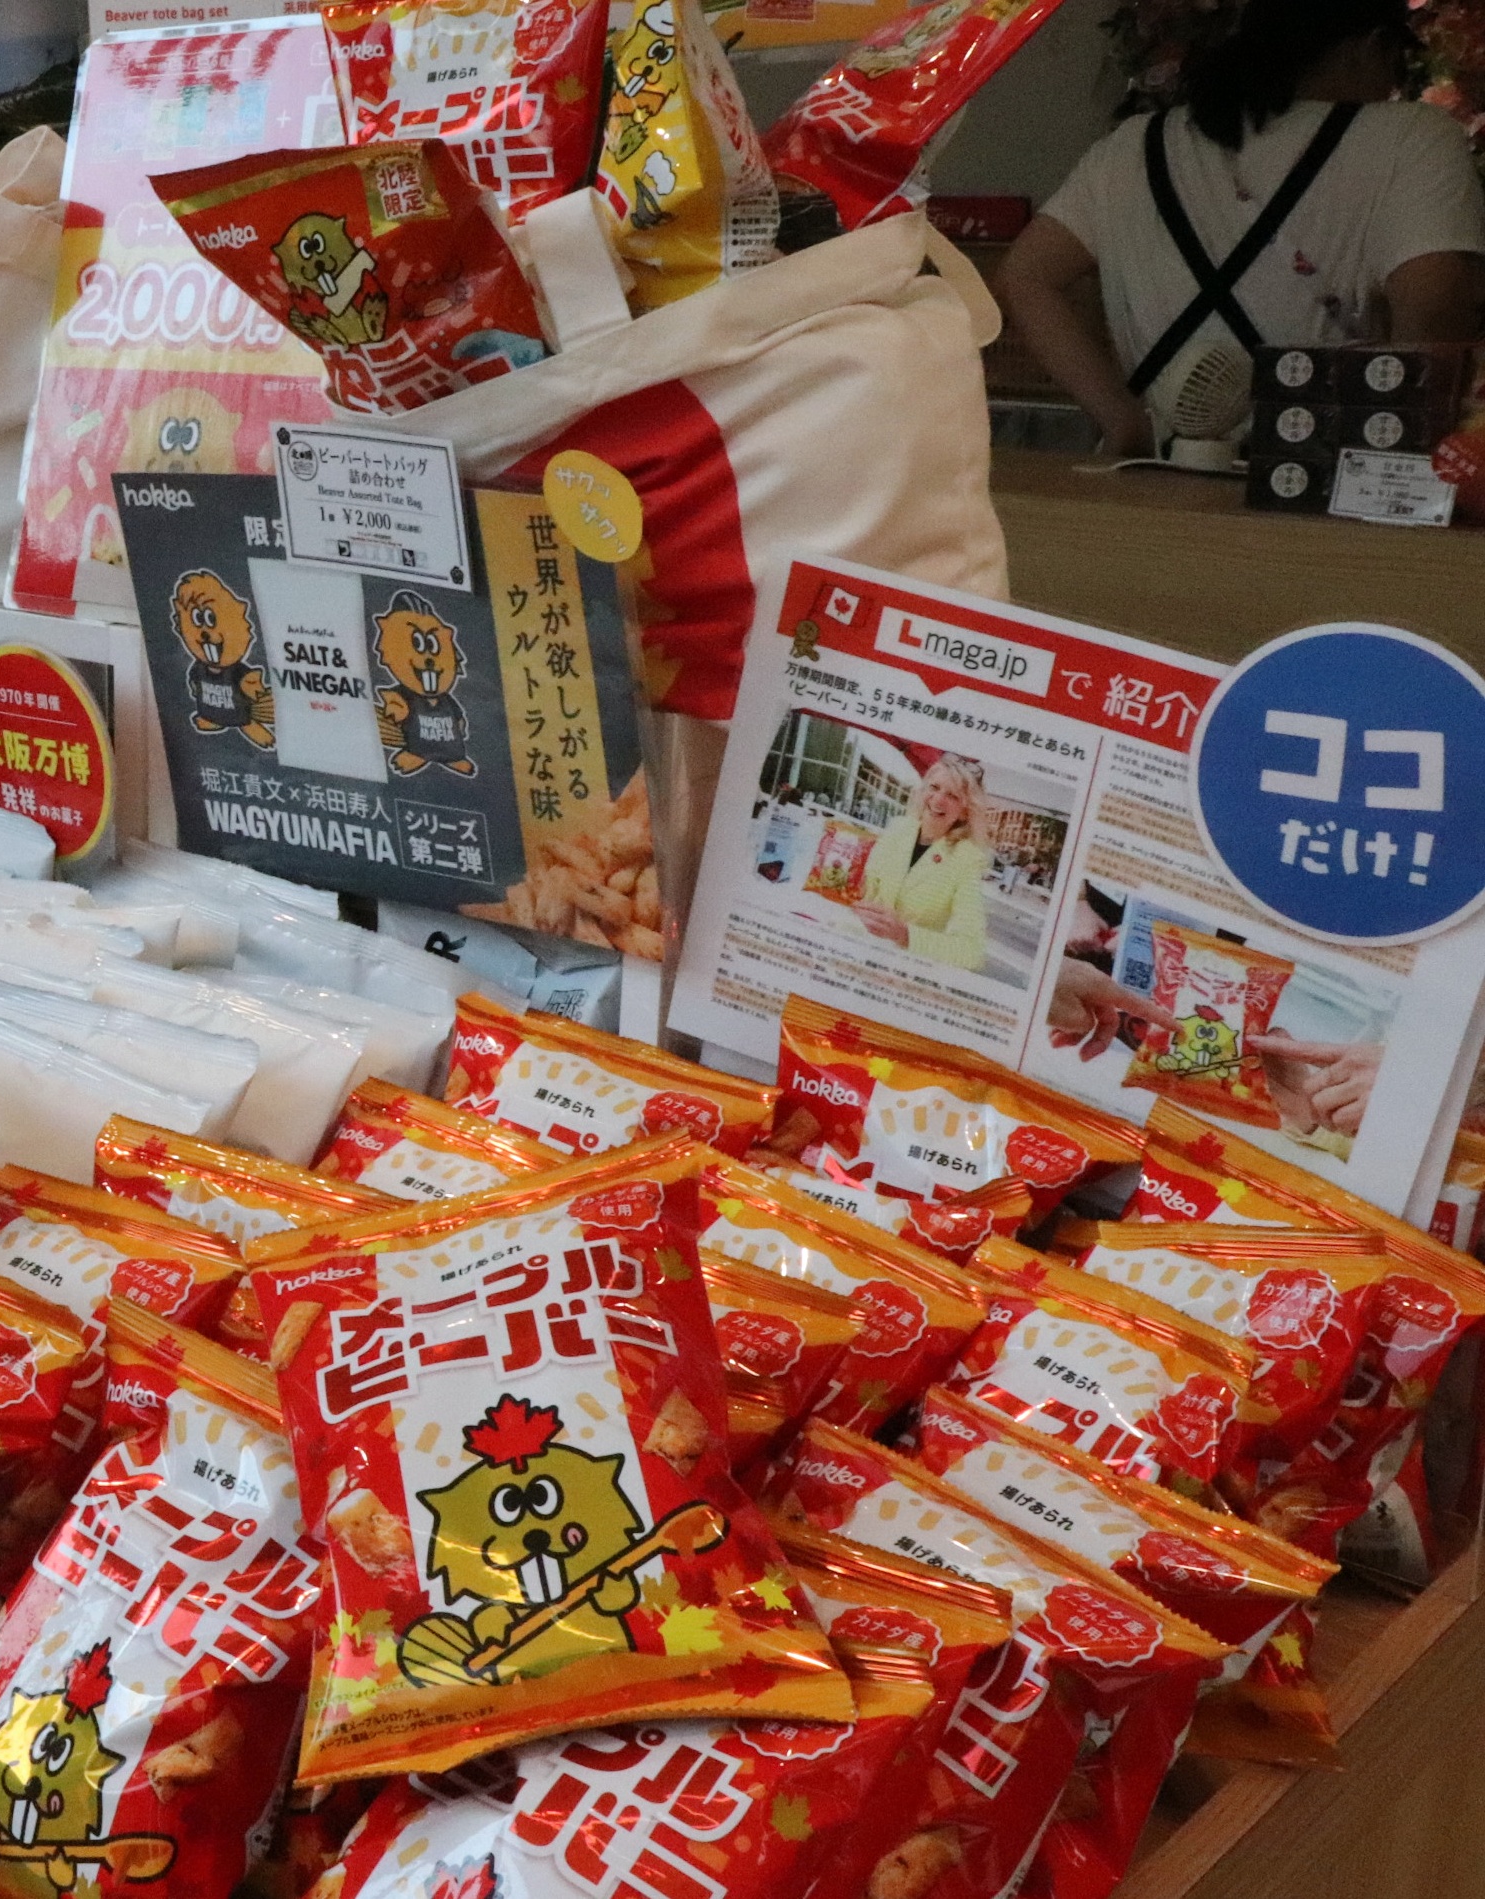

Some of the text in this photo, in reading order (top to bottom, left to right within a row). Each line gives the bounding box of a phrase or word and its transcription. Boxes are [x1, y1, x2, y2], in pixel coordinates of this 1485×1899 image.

[105, 6, 229, 22] Beaver tote bag set
[377, 162, 419, 191] 北陸
[382, 191, 425, 218] 限定
[195, 222, 259, 252] hokka
[317, 447, 428, 476] ビーバートートバッグ
[122, 483, 195, 512] hokka
[554, 466, 611, 501] サクッ
[342, 508, 392, 531] ¥2,000
[525, 513, 590, 800] 世界が欲しがる
[272, 667, 369, 700] VINEGAR
[506, 584, 562, 823] ウルトラな味
[855, 700, 896, 724] コラボ
[1058, 667, 1200, 740] で 紹介
[417, 714, 454, 730] WAGYU
[419, 725, 456, 743] MAFIA
[1258, 708, 1446, 814] ココ
[0, 780, 85, 828] 発祥のお菓子
[204, 799, 399, 867] WAGYUMAFIA
[404, 809, 479, 843] シリーズ
[408, 836, 484, 876] 第二弾
[1278, 817, 1436, 888] だけ!
[454, 1031, 505, 1057] hokka
[532, 1087, 597, 1119] 揚げあられ
[791, 1070, 860, 1107] hokka
[658, 1091, 714, 1124] カナダ産
[1019, 1121, 1078, 1165] カナダ産
[907, 1144, 979, 1176] 揚げあられ
[1018, 1153, 1048, 1173] 使用
[399, 1174, 455, 1200] 揚げあら
[599, 1204, 633, 1217] 使用
[7, 1255, 64, 1288] 揚げあられ
[131, 1258, 183, 1287] カナダ産
[440, 1244, 523, 1283] 揚げあられ
[124, 1287, 150, 1307] 使用
[275, 1265, 366, 1296] hokka
[330, 1238, 645, 1360] メープル
[862, 1291, 916, 1327] カナダ産
[732, 1314, 792, 1346] カナダ産
[315, 1300, 679, 1424] ビーバー
[727, 1341, 758, 1362] 使用
[106, 1377, 162, 1409] hokka
[1033, 1356, 1103, 1398] 揚げあられ
[192, 1457, 261, 1504] 揚げあられ
[795, 1457, 867, 1491] hokka
[999, 1485, 1075, 1533] 揚げあられ
[78, 1442, 321, 1620] メープル
[32, 1500, 292, 1684] ビーバー
[1067, 1616, 1103, 1642] 使用
[1076, 1590, 1146, 1635] カナダ産
[851, 1613, 925, 1648] カナダ産
[762, 1719, 798, 1742] 使用
